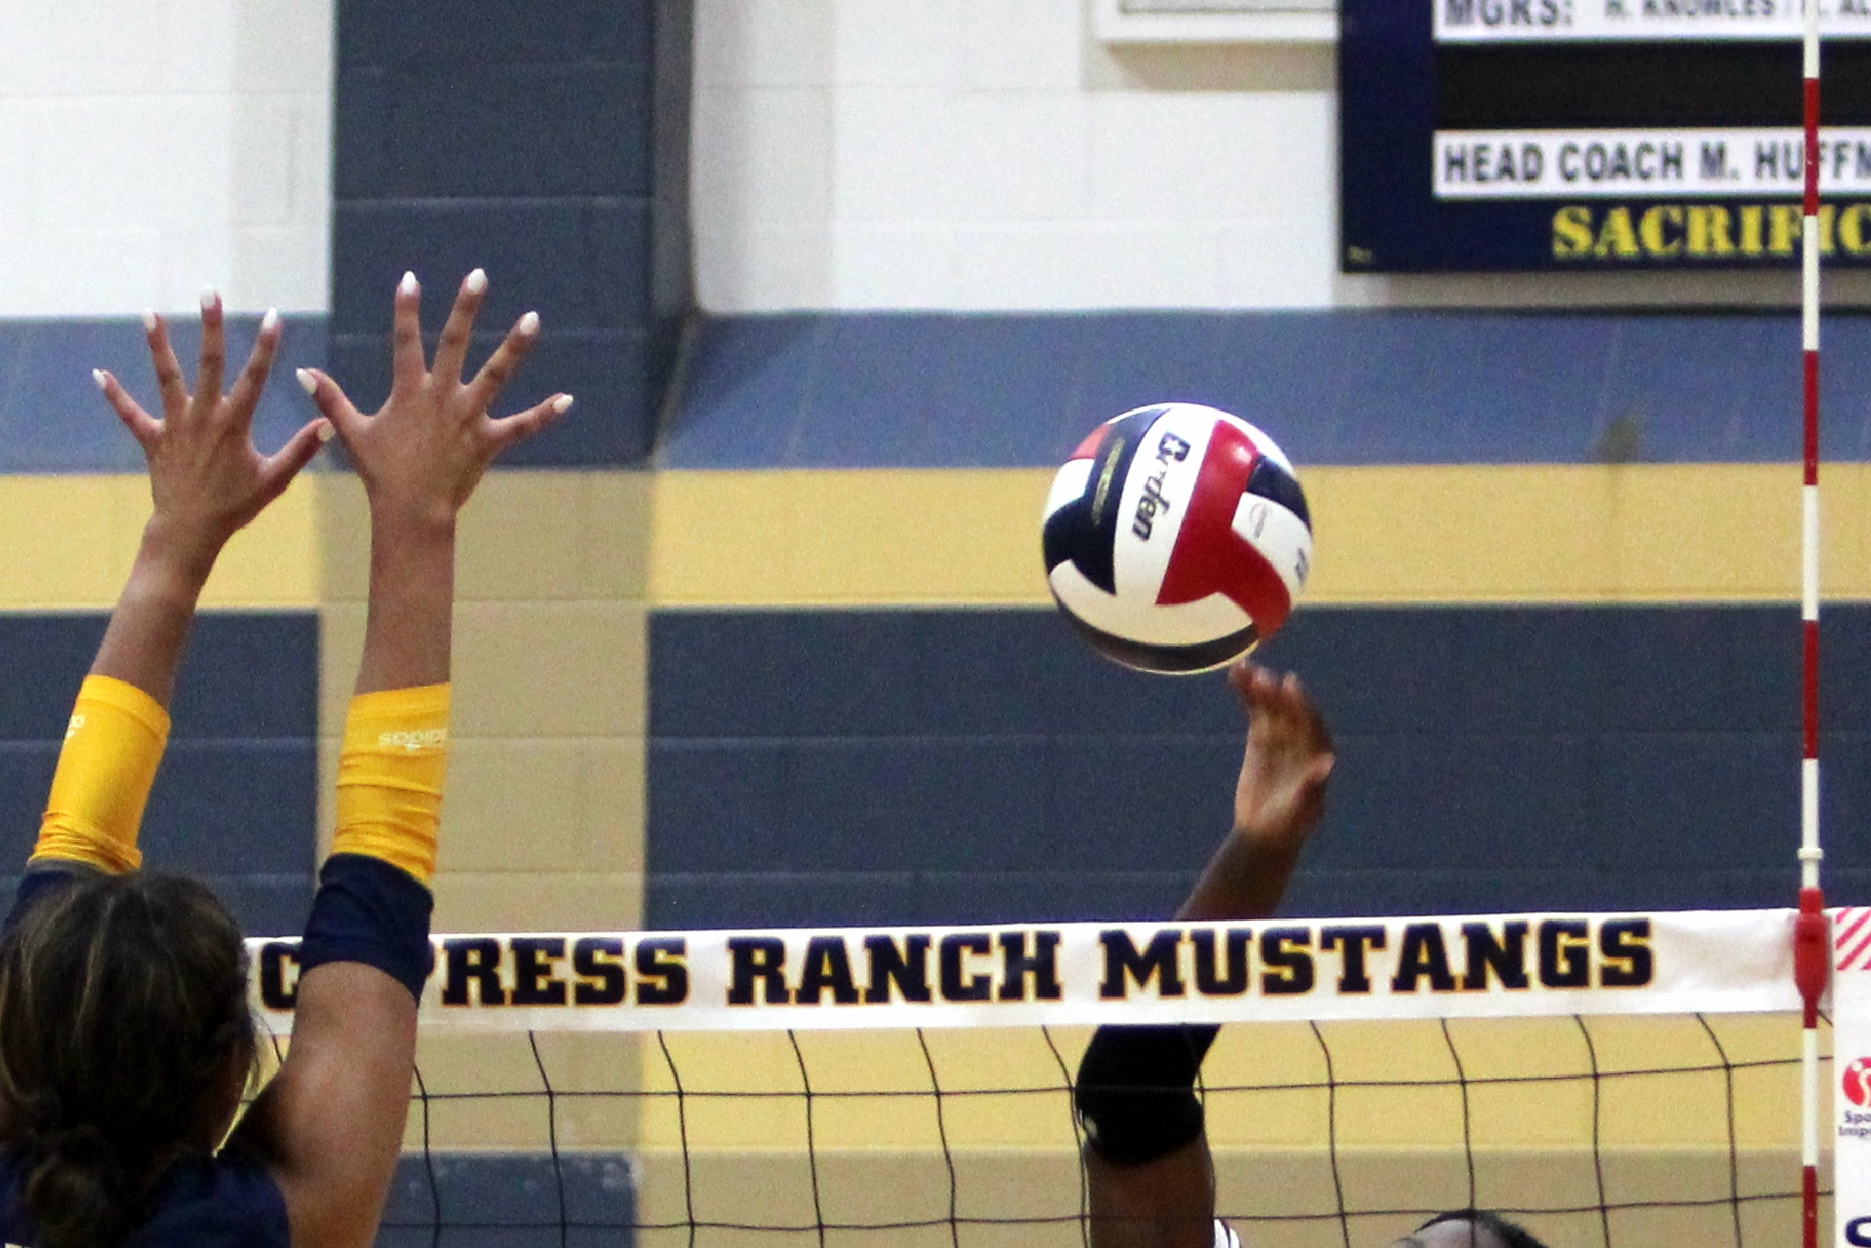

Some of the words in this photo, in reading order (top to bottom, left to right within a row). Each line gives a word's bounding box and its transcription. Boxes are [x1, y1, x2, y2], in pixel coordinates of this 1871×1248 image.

[1444, 142, 1544, 182] HEAD
[1559, 142, 1683, 182] COACH
[728, 930, 1062, 1006] RANCH
[1100, 918, 1655, 998] MUSTANGS
